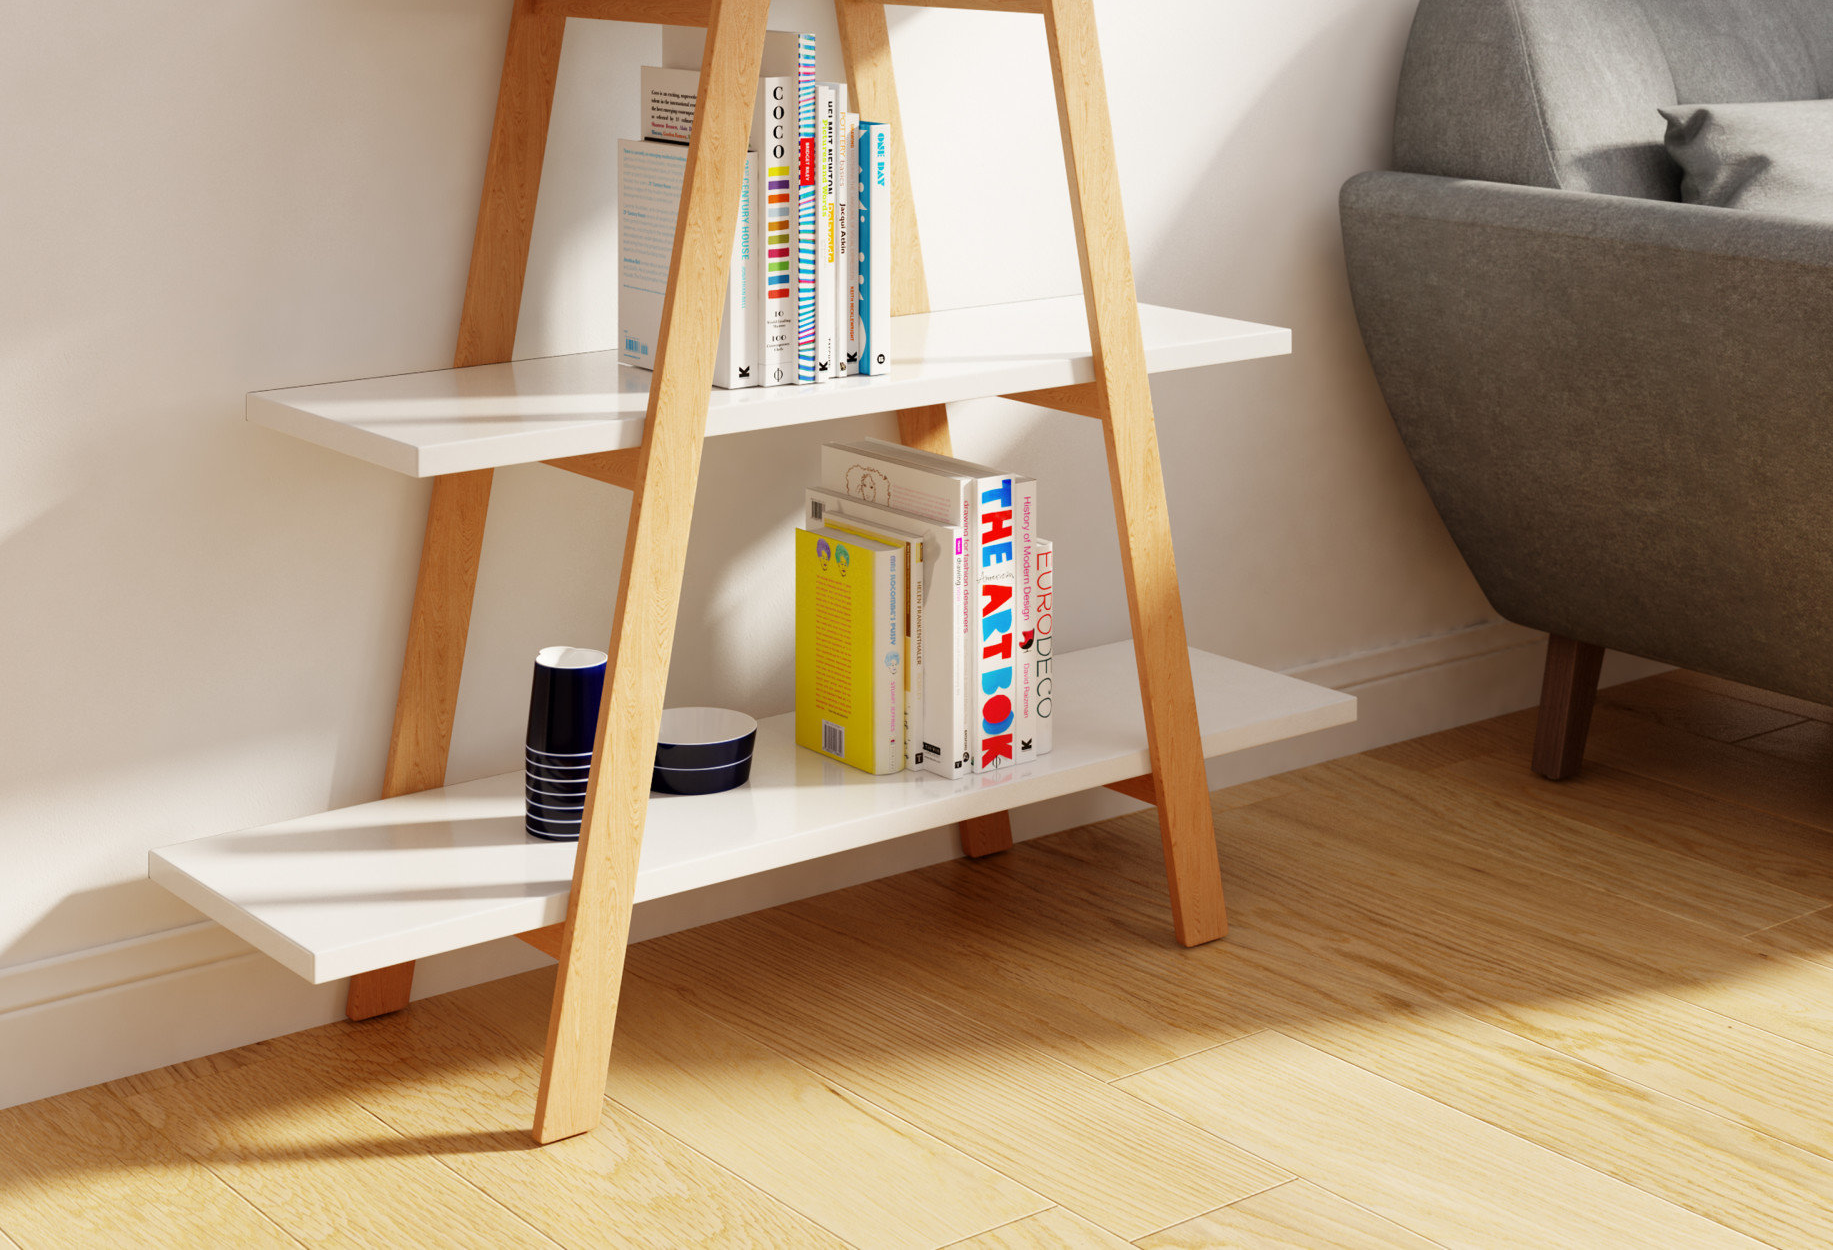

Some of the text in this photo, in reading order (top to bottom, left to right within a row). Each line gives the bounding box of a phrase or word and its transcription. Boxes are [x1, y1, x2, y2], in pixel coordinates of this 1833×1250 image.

[773, 86, 785, 160] COCO
[877, 133, 885, 187] ONE DAY
[741, 176, 750, 224] CENTURY
[741, 226, 750, 261] HOUSE
[772, 334, 787, 342] 100
[774, 310, 785, 318] 10
[981, 479, 1013, 569] THE
[1021, 496, 1031, 621] History of Modern Design
[982, 584, 1013, 659] ART
[1036, 551, 1053, 719] EURODECO
